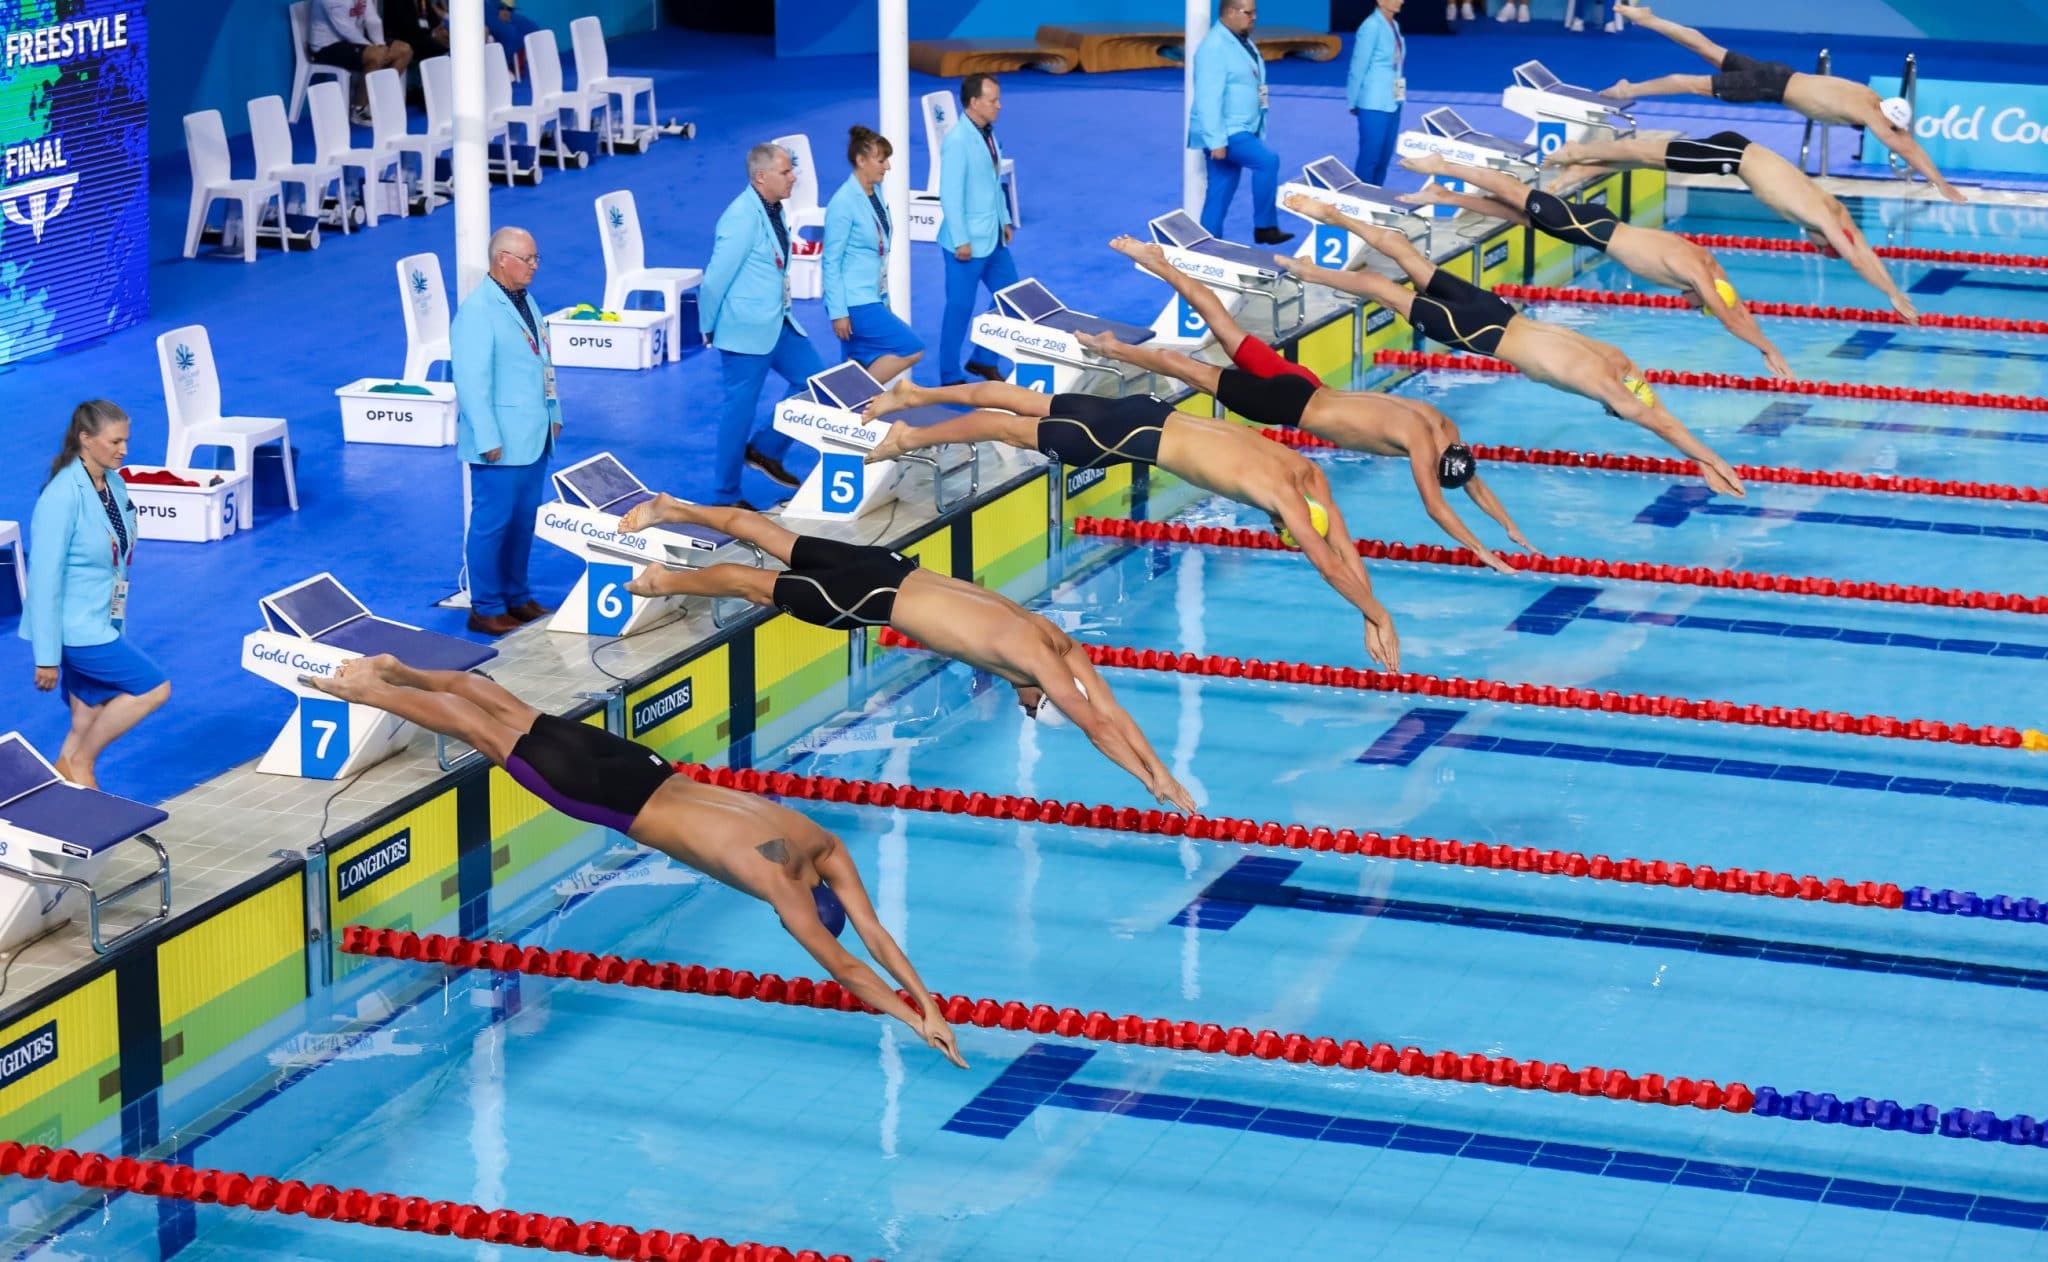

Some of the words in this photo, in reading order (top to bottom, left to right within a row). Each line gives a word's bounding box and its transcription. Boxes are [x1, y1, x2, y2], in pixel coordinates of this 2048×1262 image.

[6, 13, 128, 67] FREESTYLE
[1915, 105, 1985, 140] old
[6, 138, 67, 179] FINAL
[909, 215, 935, 225] PTUS
[1172, 257, 1201, 272] Coast
[1202, 265, 1225, 278] 2018
[1322, 238, 1342, 264] 2
[569, 336, 613, 348] OPTUS
[653, 328, 661, 355] 3
[979, 322, 1007, 339] Gold
[1010, 330, 1041, 347] Coast
[1043, 338, 1067, 353] 2018
[366, 409, 413, 422] OPTUS
[782, 409, 814, 427] Gold
[816, 417, 850, 436] Coast
[851, 427, 877, 443] 2018
[830, 471, 855, 504] 5
[136, 505, 177, 518] PTUS
[223, 492, 234, 524] 5
[545, 513, 579, 533] Gold
[581, 522, 617, 543] Coast
[619, 533, 648, 550] 2018
[597, 583, 623, 618] 6
[252, 643, 289, 665] Gold
[291, 653, 331, 676] Coast
[635, 685, 690, 729] LONGINES
[311, 719, 337, 760] 7
[340, 838, 407, 891] LONGINES
[0, 1031, 54, 1080] GINES
